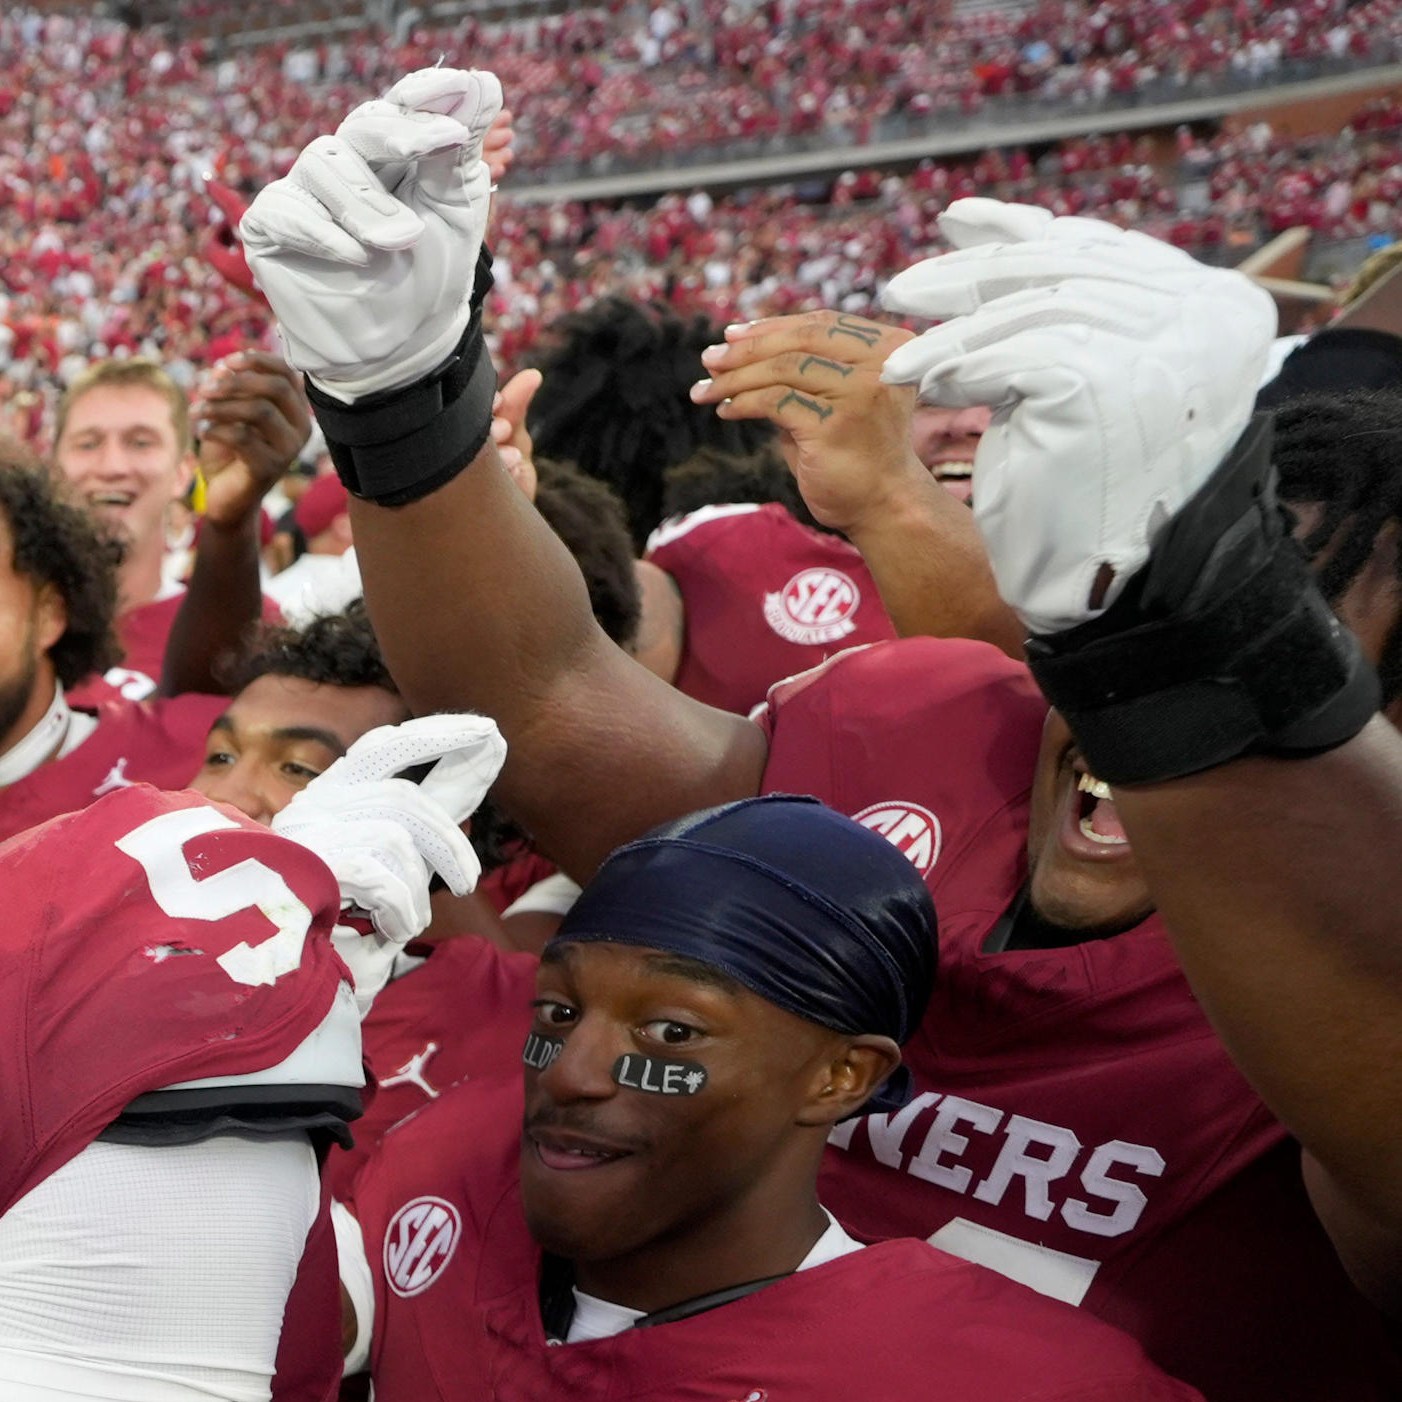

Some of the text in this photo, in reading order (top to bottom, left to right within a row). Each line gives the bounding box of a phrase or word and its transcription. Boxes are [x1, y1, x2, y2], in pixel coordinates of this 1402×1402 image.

[786, 572, 853, 624] SEC
[115, 806, 313, 987] 5
[387, 1203, 456, 1292] SEC
